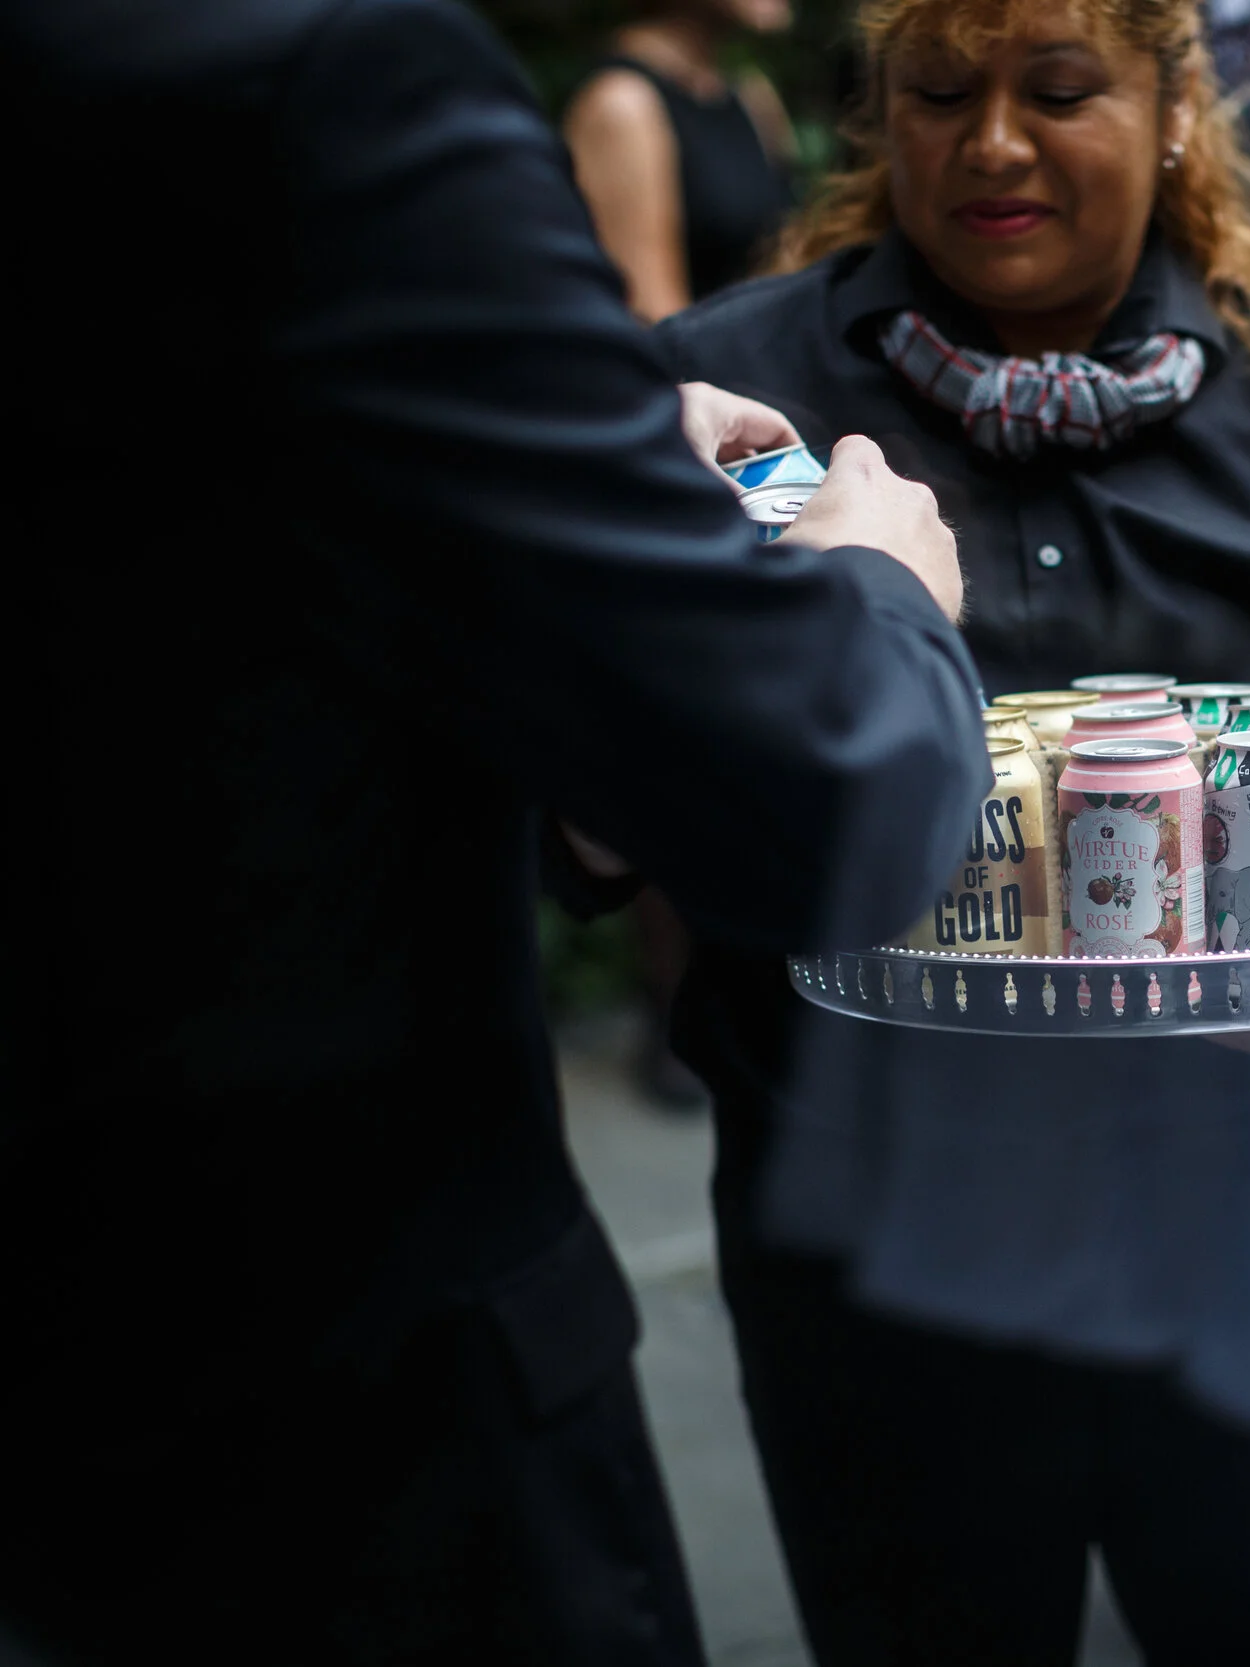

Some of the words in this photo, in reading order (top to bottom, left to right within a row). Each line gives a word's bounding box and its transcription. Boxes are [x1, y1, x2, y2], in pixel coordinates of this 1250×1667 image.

[966, 795, 1025, 864] OSS
[1071, 831, 1150, 862] VIRTUE
[964, 866, 989, 889] OF
[1083, 859, 1139, 870] CIDER
[934, 883, 1023, 947] GOLD
[1086, 912, 1135, 931] ROSÉ
